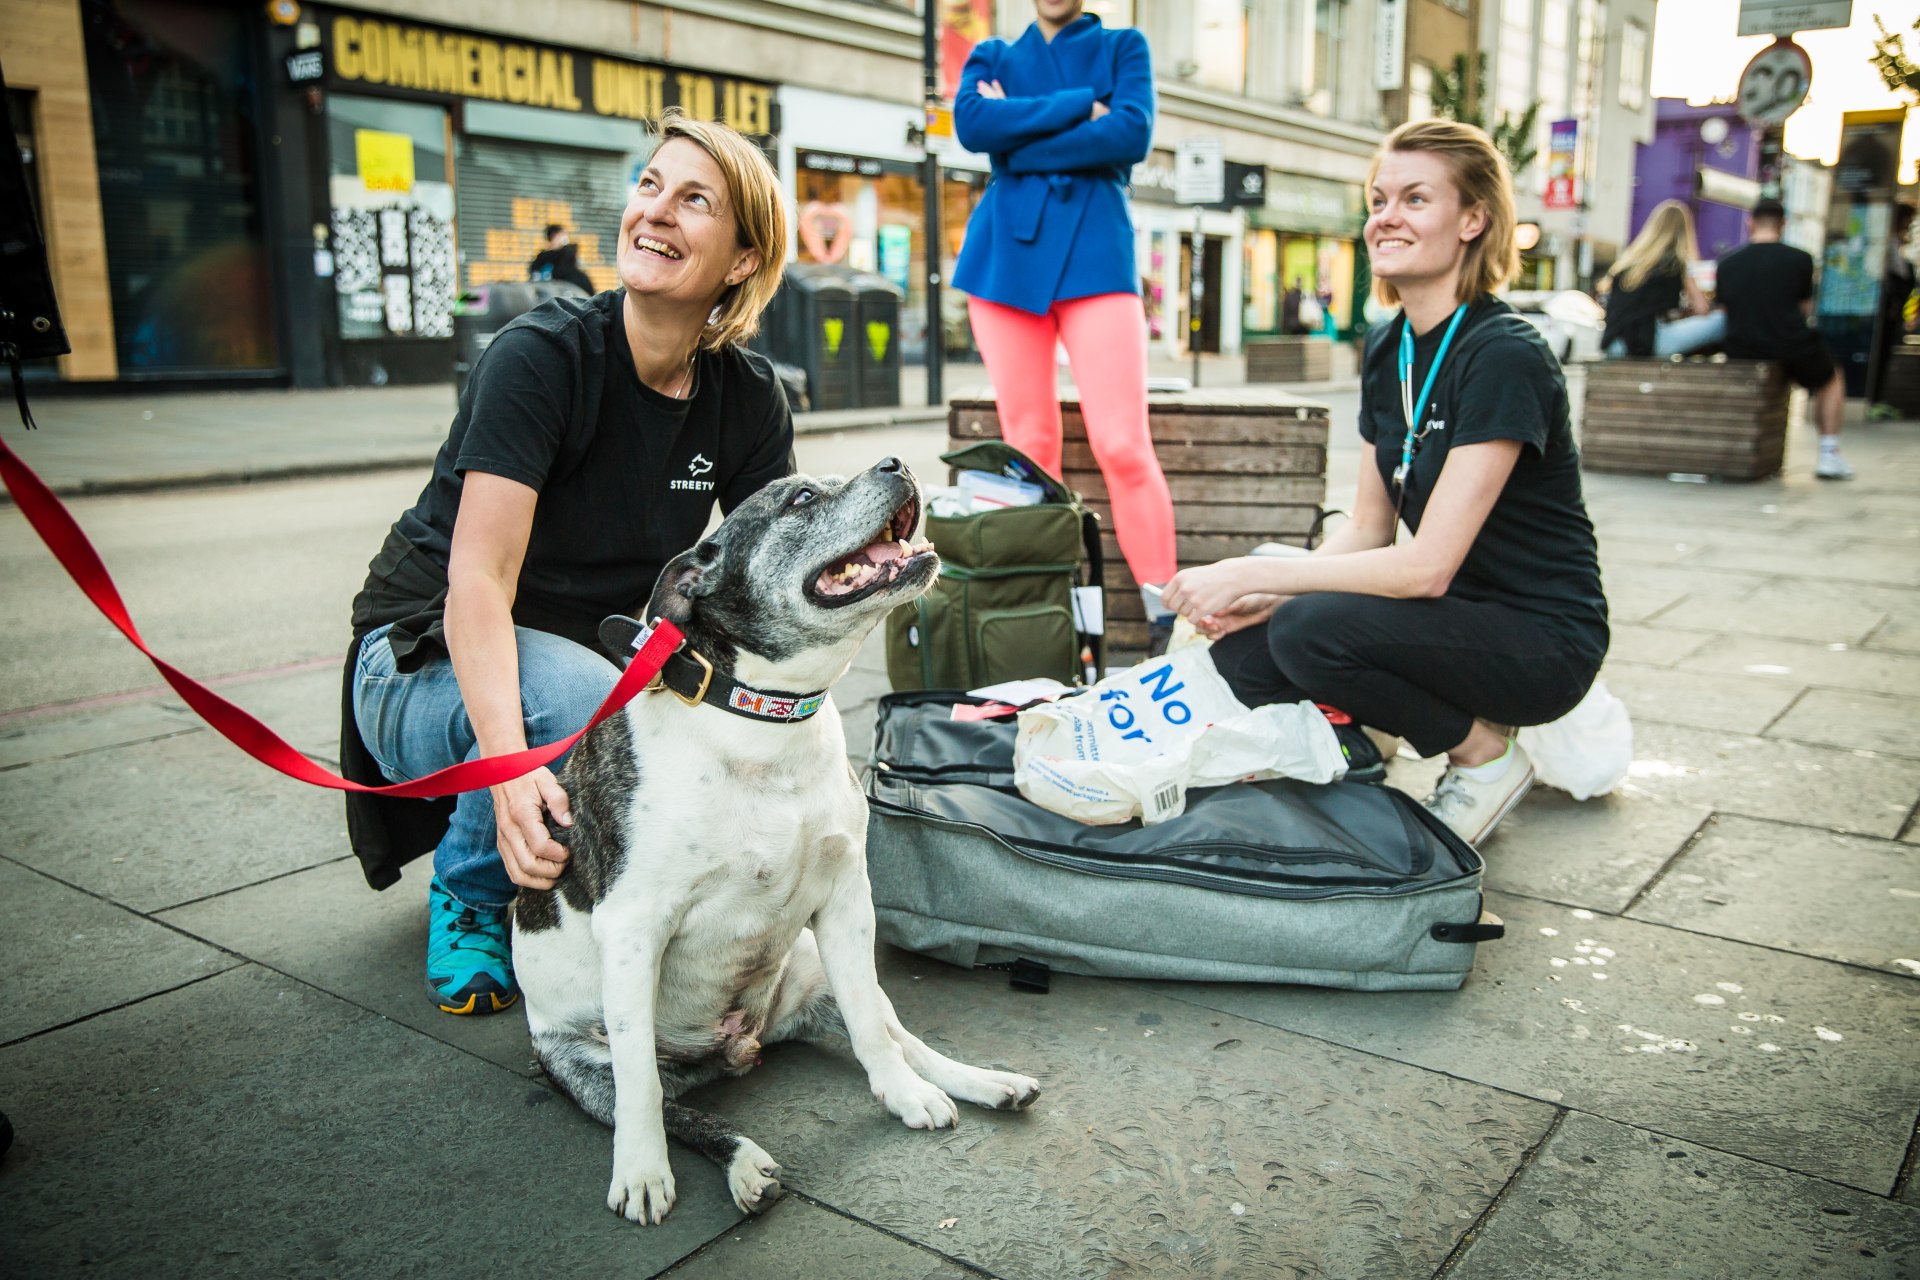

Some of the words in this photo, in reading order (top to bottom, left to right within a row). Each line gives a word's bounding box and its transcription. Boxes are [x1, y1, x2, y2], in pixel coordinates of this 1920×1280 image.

[287, 52, 323, 81] VANS
[333, 15, 582, 112] COMMERCIAL
[591, 58, 667, 119] UNIT
[676, 70, 716, 123] TO
[723, 80, 772, 137] LET
[1100, 689, 1153, 743] for
[1139, 663, 1192, 725] No
[1075, 735, 1085, 761] from
